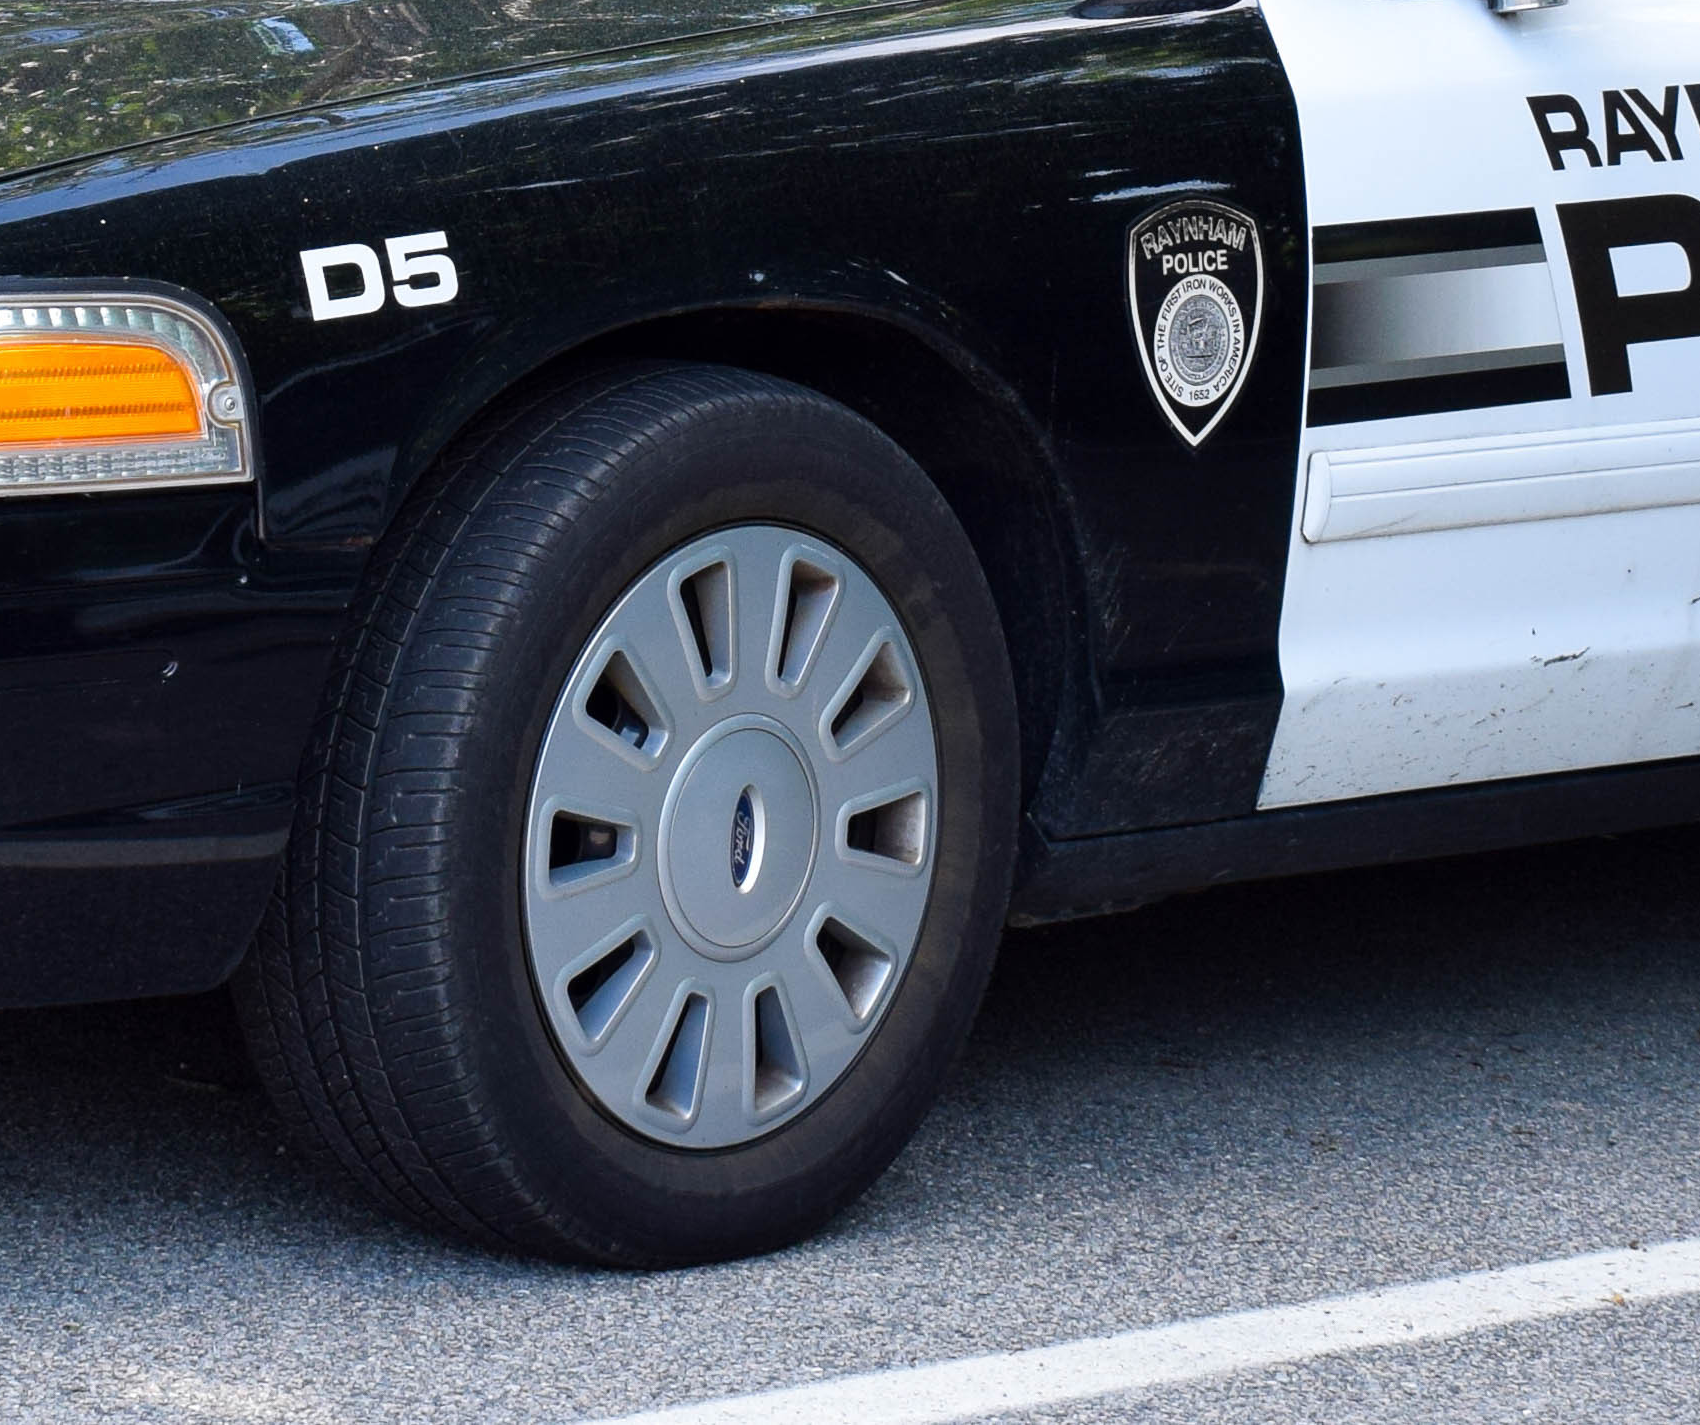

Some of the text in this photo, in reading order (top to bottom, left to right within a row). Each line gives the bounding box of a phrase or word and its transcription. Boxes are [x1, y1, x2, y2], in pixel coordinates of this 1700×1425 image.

[1140, 216, 1246, 260] RAYNHAM
[300, 230, 459, 322] D5
[1162, 249, 1229, 275] POLICE
[1157, 278, 1241, 398] SITE OF THE FIRST IRON WORKS IN AMERICA
[1189, 389, 1210, 401] 1652
